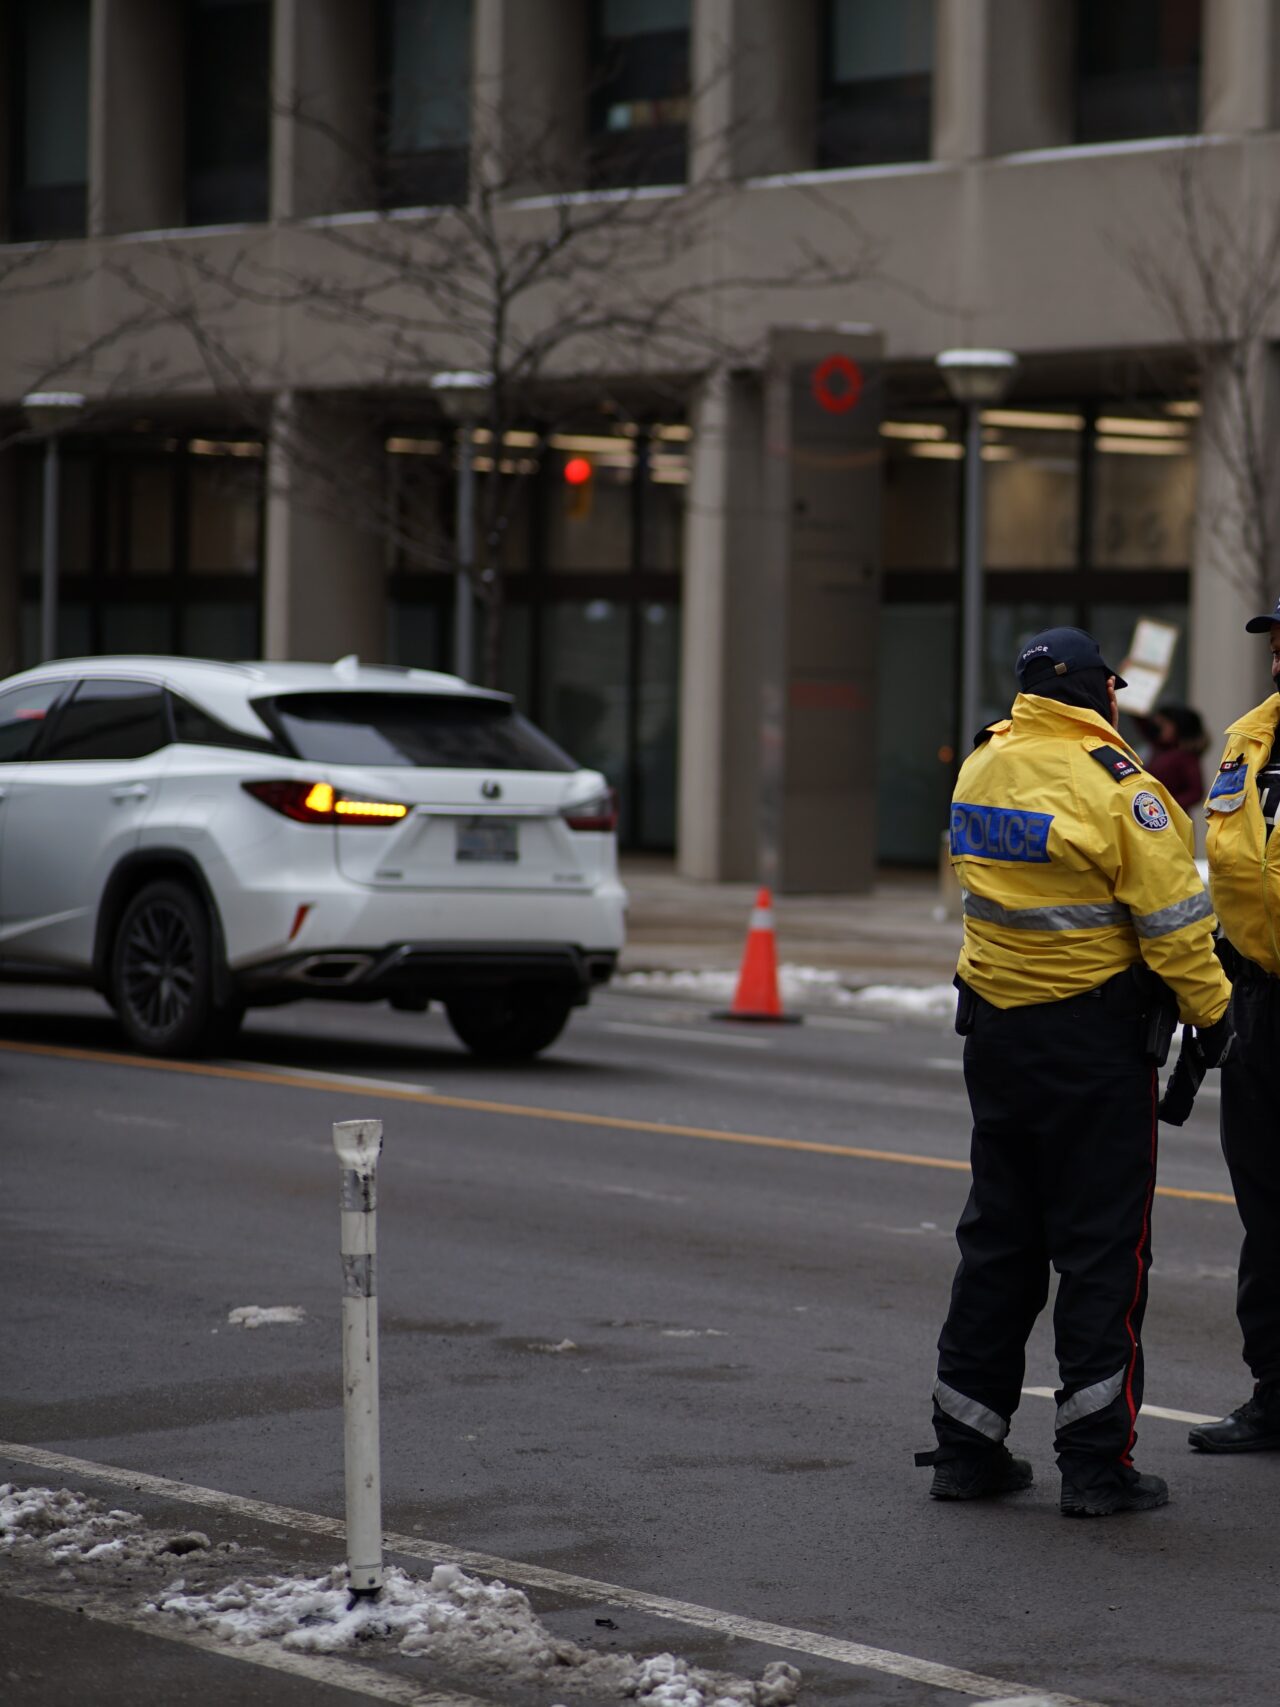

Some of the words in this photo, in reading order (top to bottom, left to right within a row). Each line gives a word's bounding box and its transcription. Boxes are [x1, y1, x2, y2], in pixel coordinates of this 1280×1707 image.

[1022, 645, 1049, 660] POLICE
[1149, 816, 1167, 828] POLIC
[951, 809, 1044, 858] POLICE
